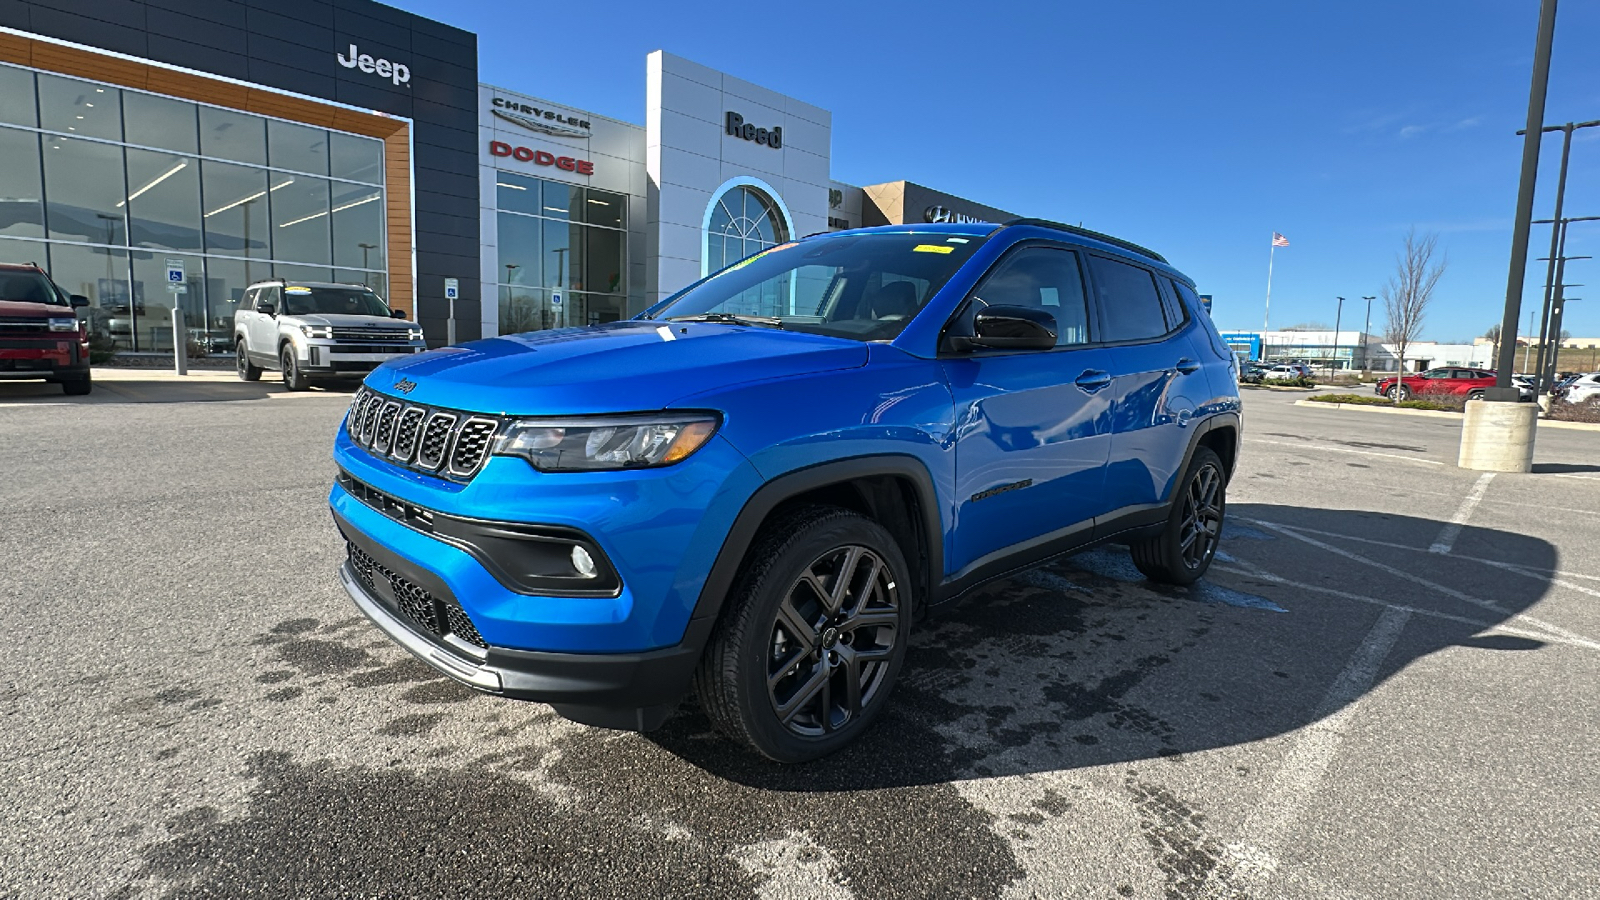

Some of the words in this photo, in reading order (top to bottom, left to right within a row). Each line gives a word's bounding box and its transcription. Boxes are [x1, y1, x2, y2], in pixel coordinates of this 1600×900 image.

[337, 44, 411, 86] Jeep
[491, 97, 591, 130] CHRYSLER
[726, 111, 783, 149] Reed
[491, 140, 594, 176] DODGE
[393, 377, 417, 395] Jeep
